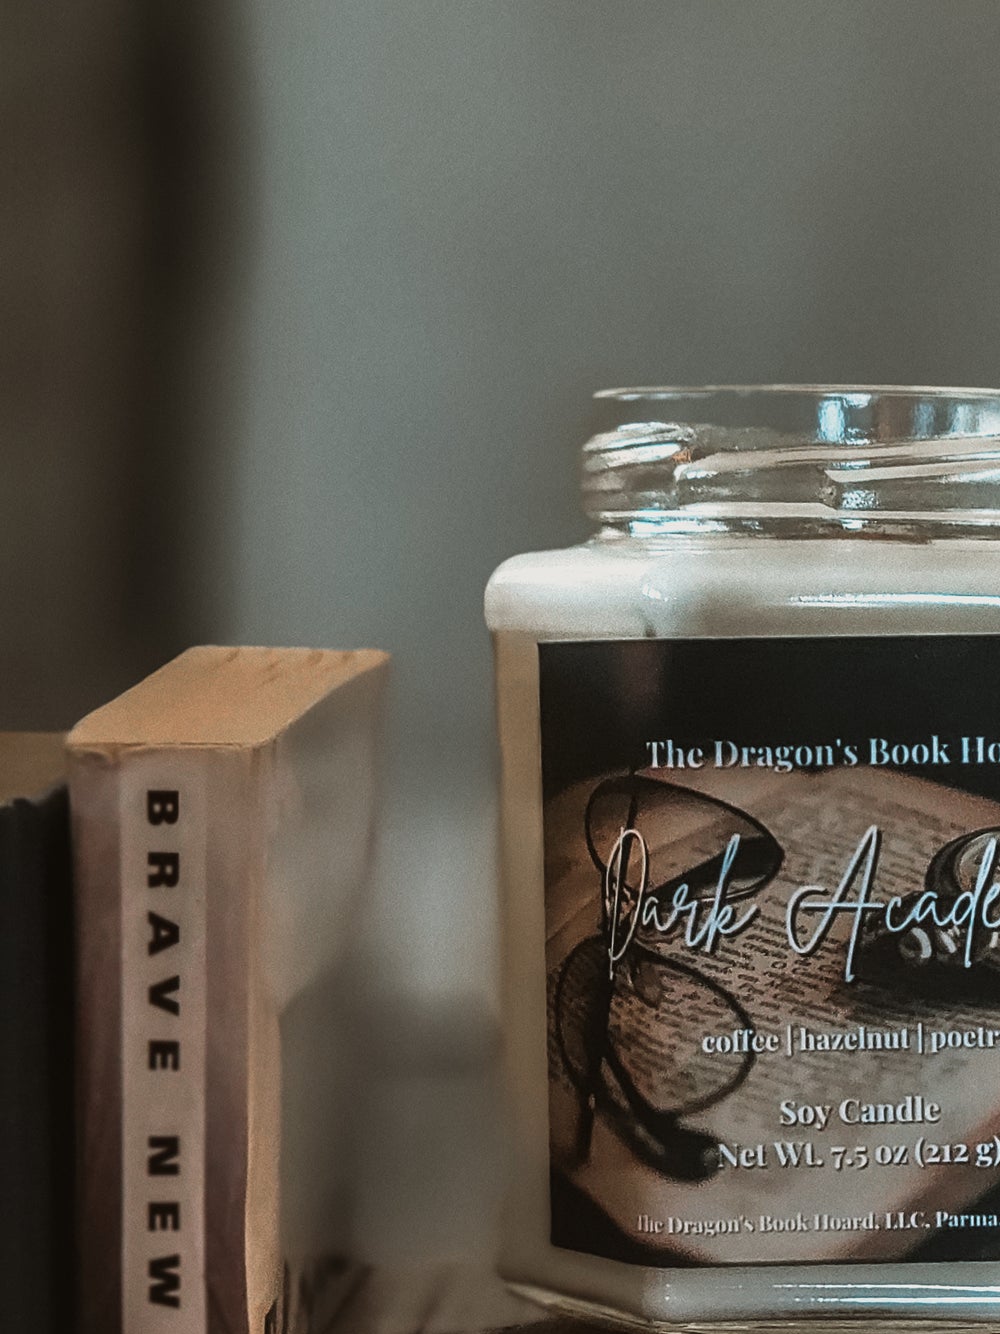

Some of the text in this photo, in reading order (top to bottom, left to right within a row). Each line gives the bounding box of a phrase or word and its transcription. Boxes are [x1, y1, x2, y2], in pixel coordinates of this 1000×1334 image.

[646, 739, 703, 768] The
[714, 737, 858, 773] Dragon's
[869, 735, 949, 766] Book
[606, 825, 761, 980] Dark
[147, 789, 181, 1072] BRAVE
[702, 1029, 779, 1053] coffee
[800, 1025, 910, 1051] hazelnut
[780, 1096, 941, 1129] Soy Candle
[718, 1142, 766, 1168] Net
[773, 1140, 824, 1167] Wt.
[830, 1146, 869, 1169] 7.5
[875, 1144, 908, 1166] oz
[914, 1137, 970, 1168] (212
[147, 1135, 182, 1309] NEW
[637, 1214, 665, 1232] The
[668, 1213, 753, 1236] Dragon's
[758, 1213, 809, 1231] Book
